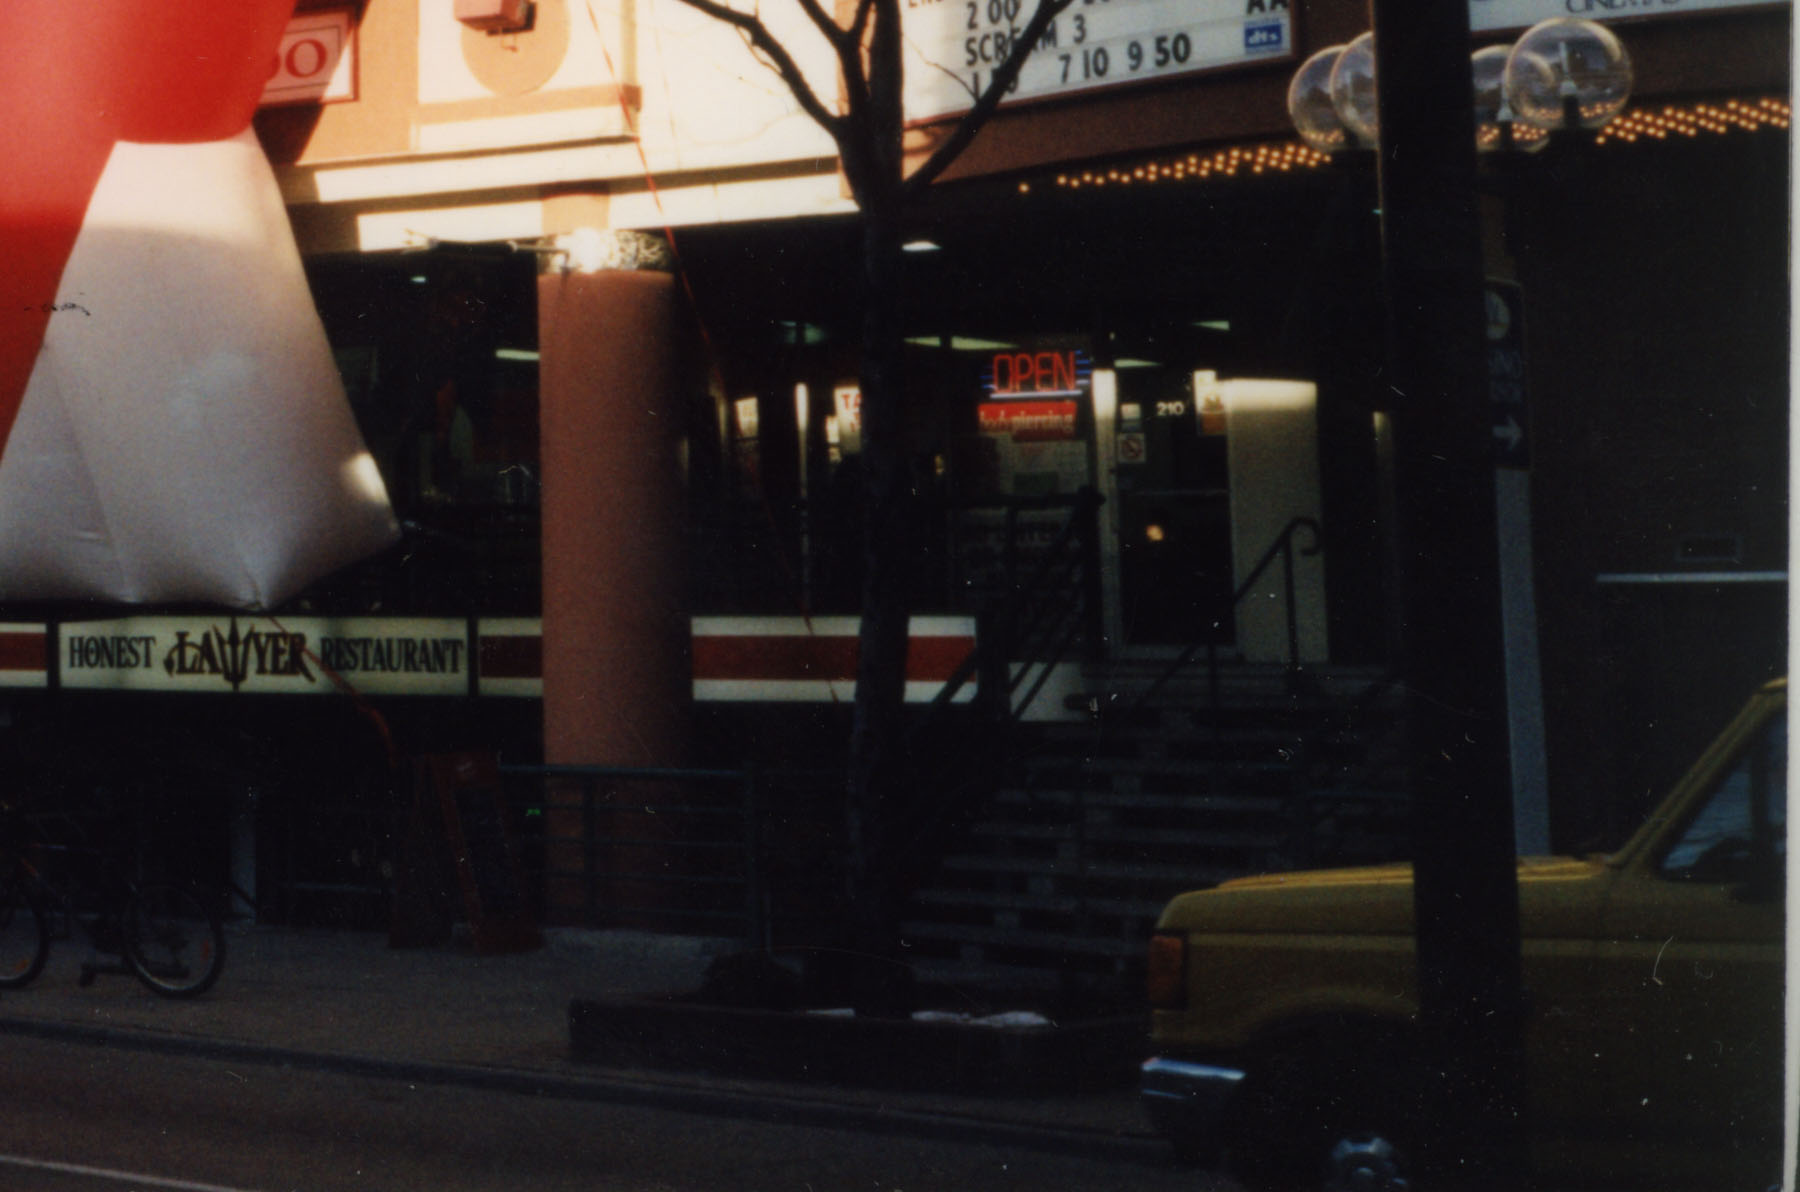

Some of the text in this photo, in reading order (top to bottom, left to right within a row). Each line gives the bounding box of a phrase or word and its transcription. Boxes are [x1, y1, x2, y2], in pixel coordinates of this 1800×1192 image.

[965, 12, 1087, 67] SCRM 3
[993, 351, 1076, 394] OPEN
[1156, 400, 1185, 417] 210
[69, 616, 464, 693] HONEST LAWYER RESTAURANT
